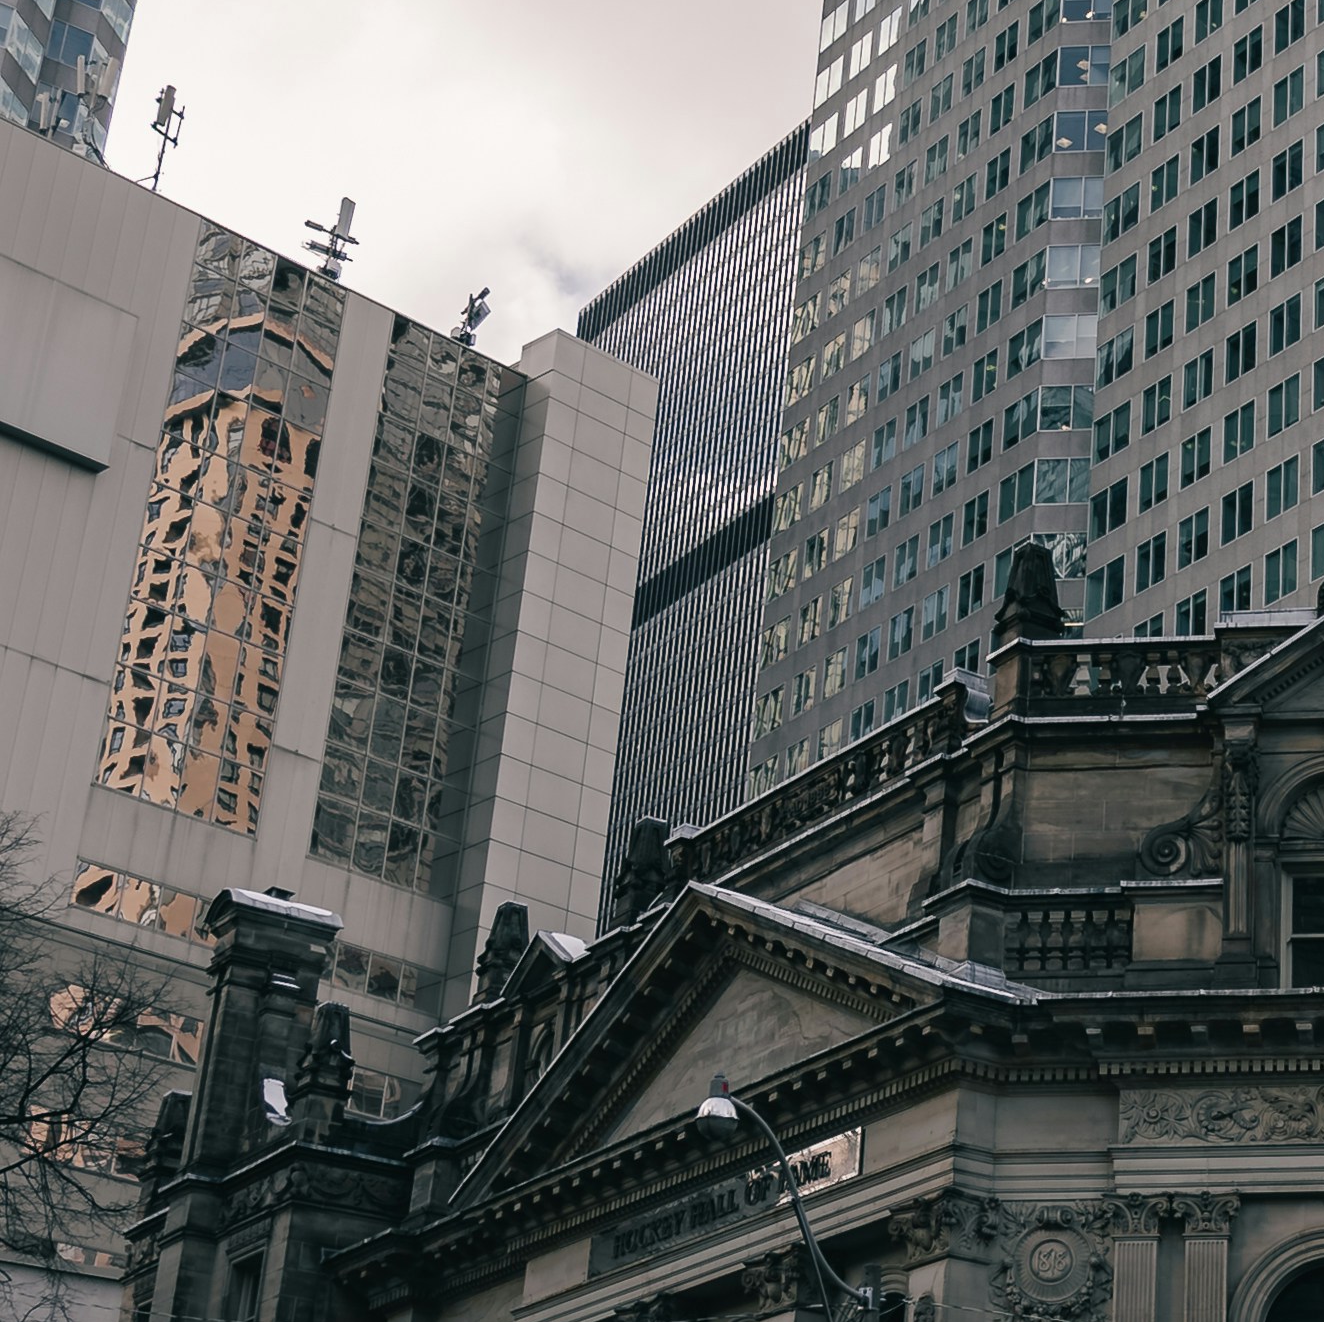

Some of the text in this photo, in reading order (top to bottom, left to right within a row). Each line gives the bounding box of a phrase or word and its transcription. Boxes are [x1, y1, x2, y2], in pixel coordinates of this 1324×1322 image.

[612, 1151, 832, 1259] HOCKEY HALL OF FAME
